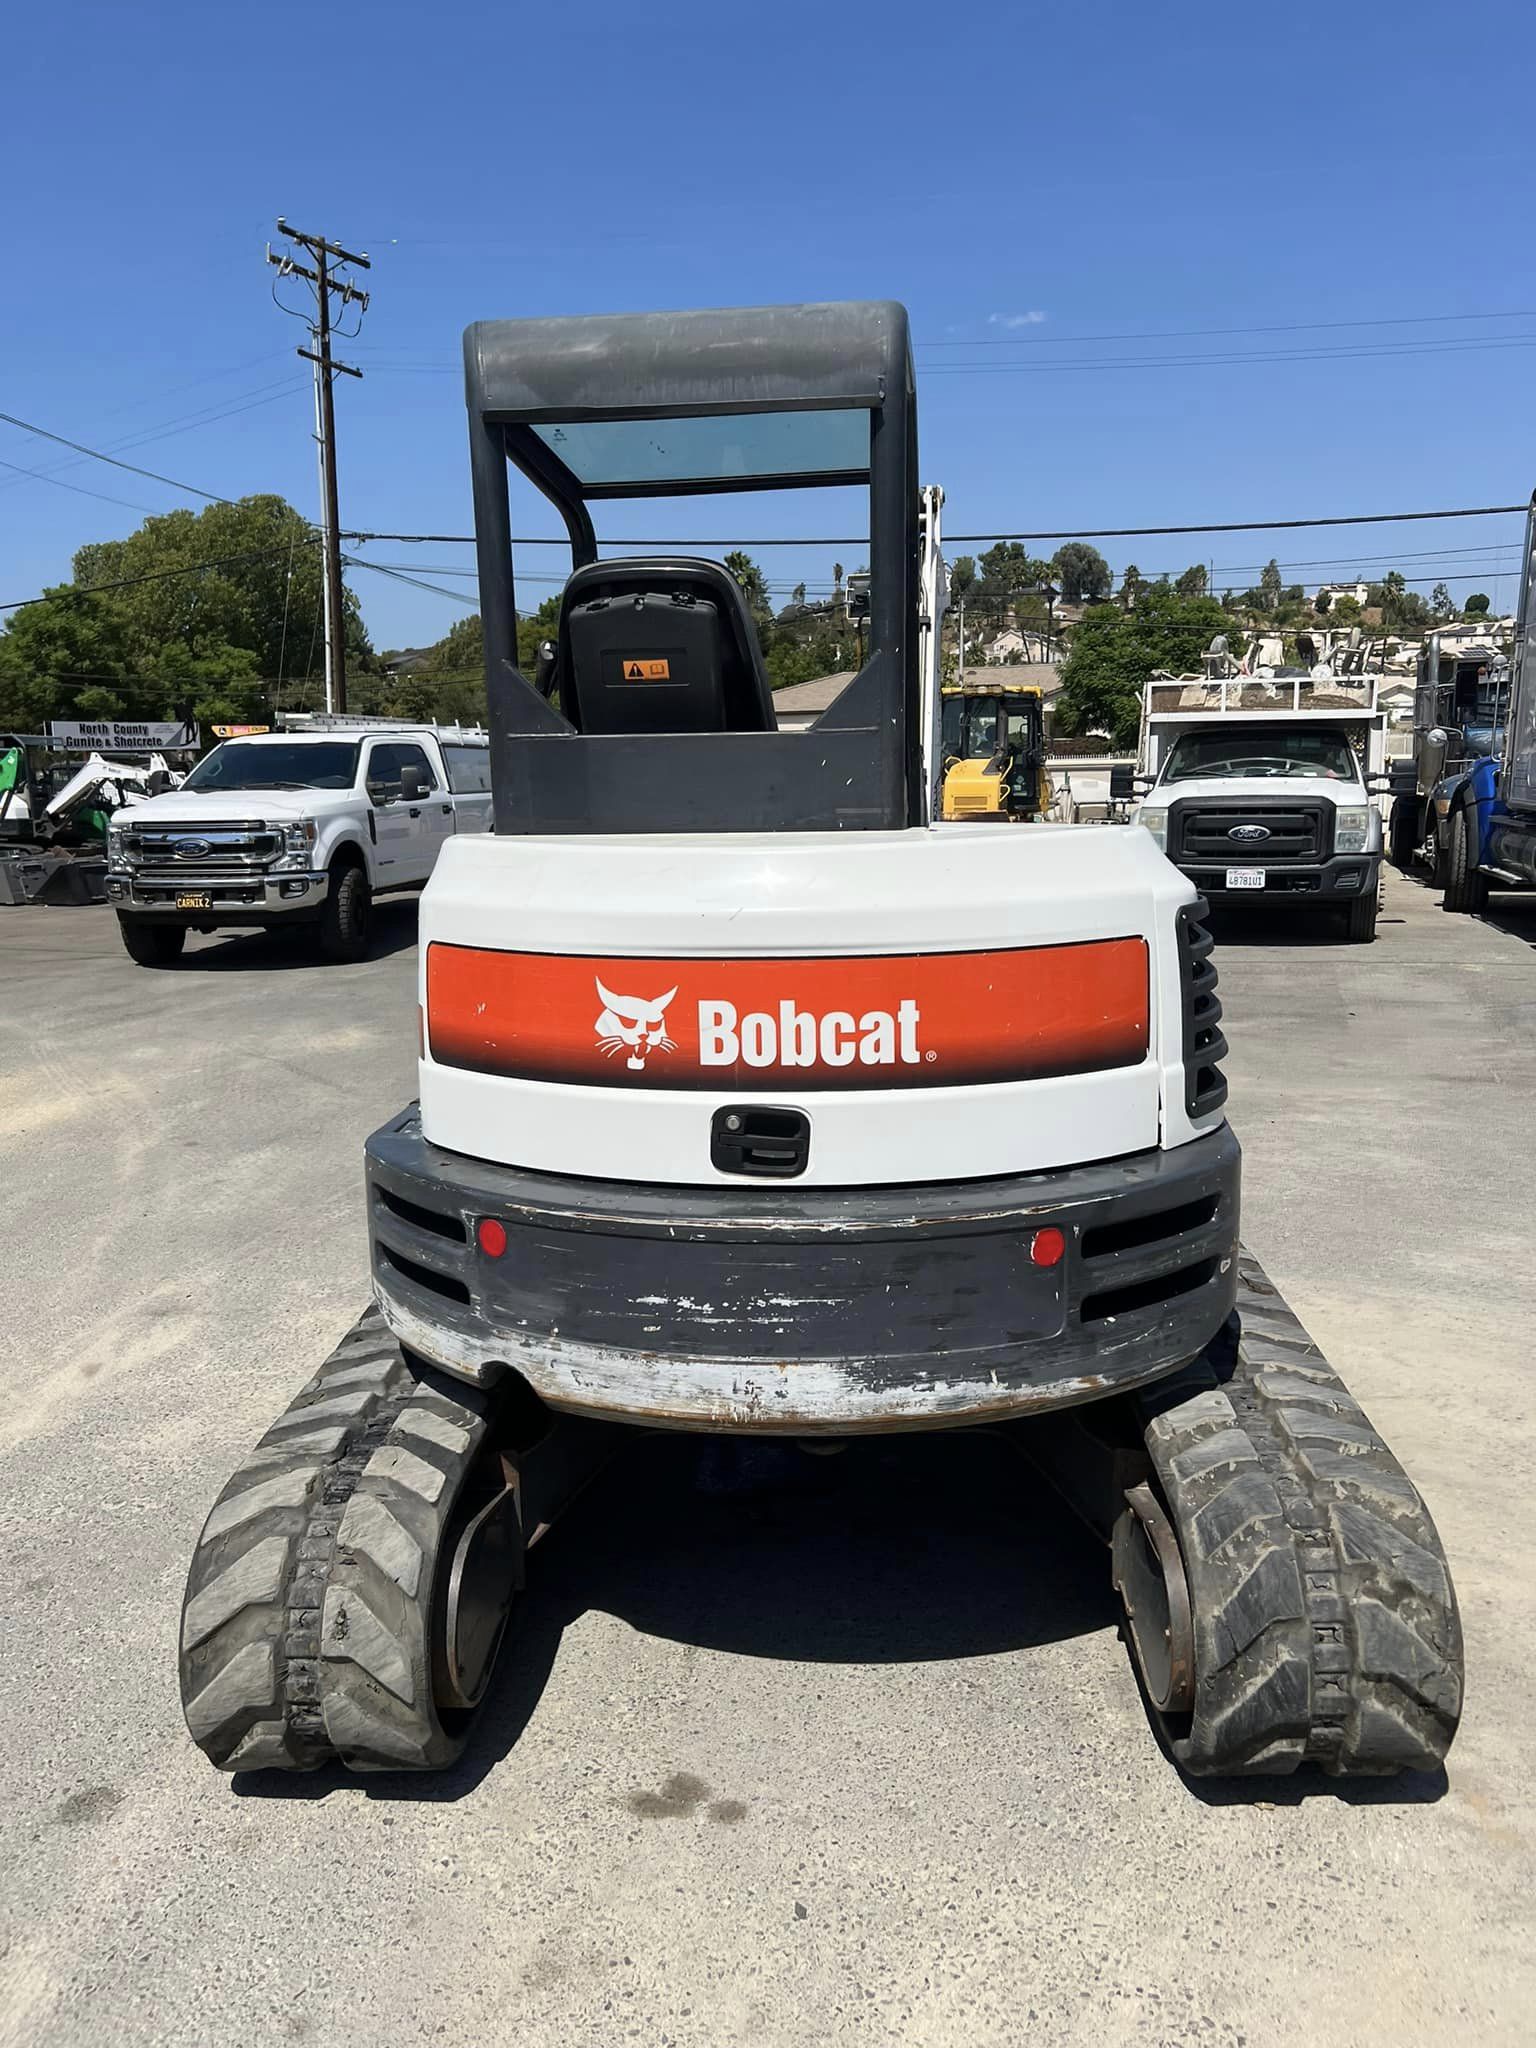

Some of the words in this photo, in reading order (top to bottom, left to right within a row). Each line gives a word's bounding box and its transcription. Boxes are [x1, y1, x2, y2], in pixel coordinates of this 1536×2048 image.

[79, 723, 108, 734] North
[113, 723, 149, 735] County
[66, 736, 102, 747] Gunite
[114, 736, 162, 747] Shotcrete
[698, 999, 921, 1068] Bobcat
